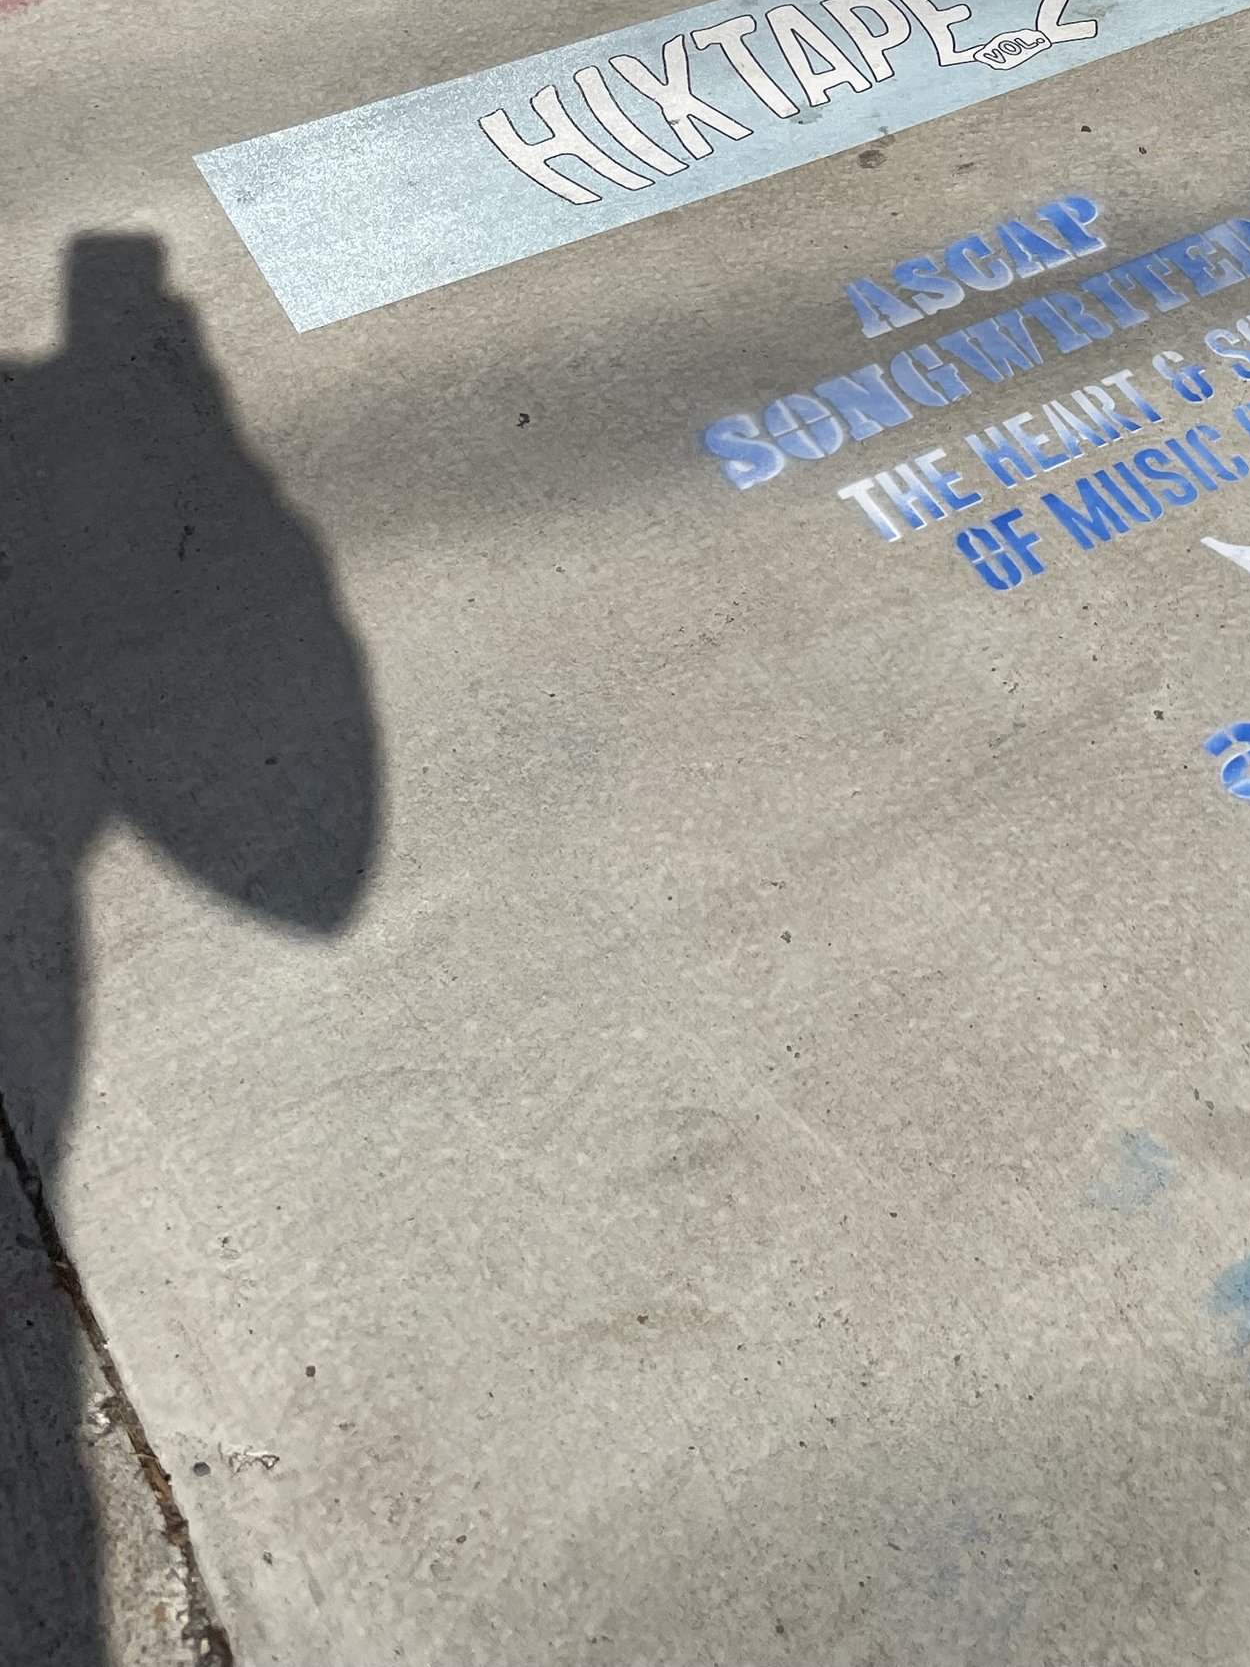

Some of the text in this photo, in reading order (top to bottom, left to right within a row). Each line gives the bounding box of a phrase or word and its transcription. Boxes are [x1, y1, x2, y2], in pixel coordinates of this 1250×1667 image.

[983, 34, 1044, 67] VOL.
[843, 195, 1107, 339] ASCAP
[837, 447, 982, 543] THE
[964, 369, 1162, 489] HEART
[1151, 350, 1212, 404] &
[954, 508, 1048, 592] OF
[1039, 422, 1250, 551] MUSIC
